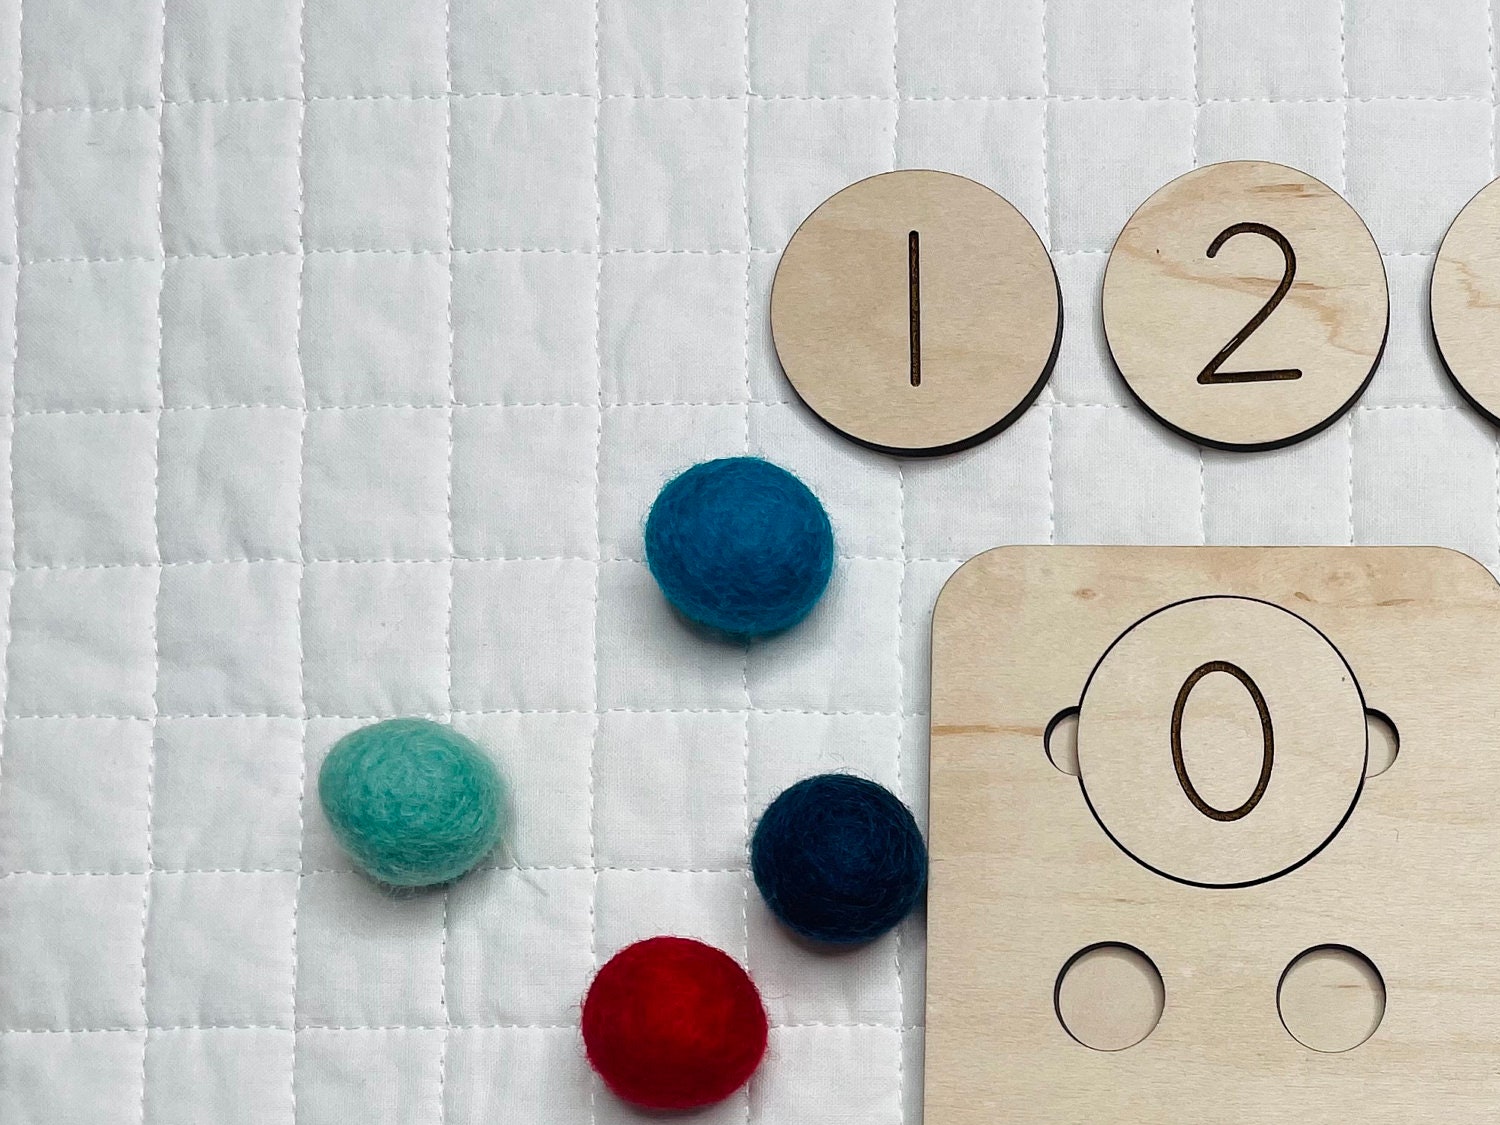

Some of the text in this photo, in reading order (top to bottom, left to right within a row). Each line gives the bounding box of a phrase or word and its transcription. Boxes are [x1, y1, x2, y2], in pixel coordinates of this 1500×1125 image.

[908, 230, 922, 387] 1
[1196, 221, 1303, 385] 2
[1170, 660, 1275, 822] 0
